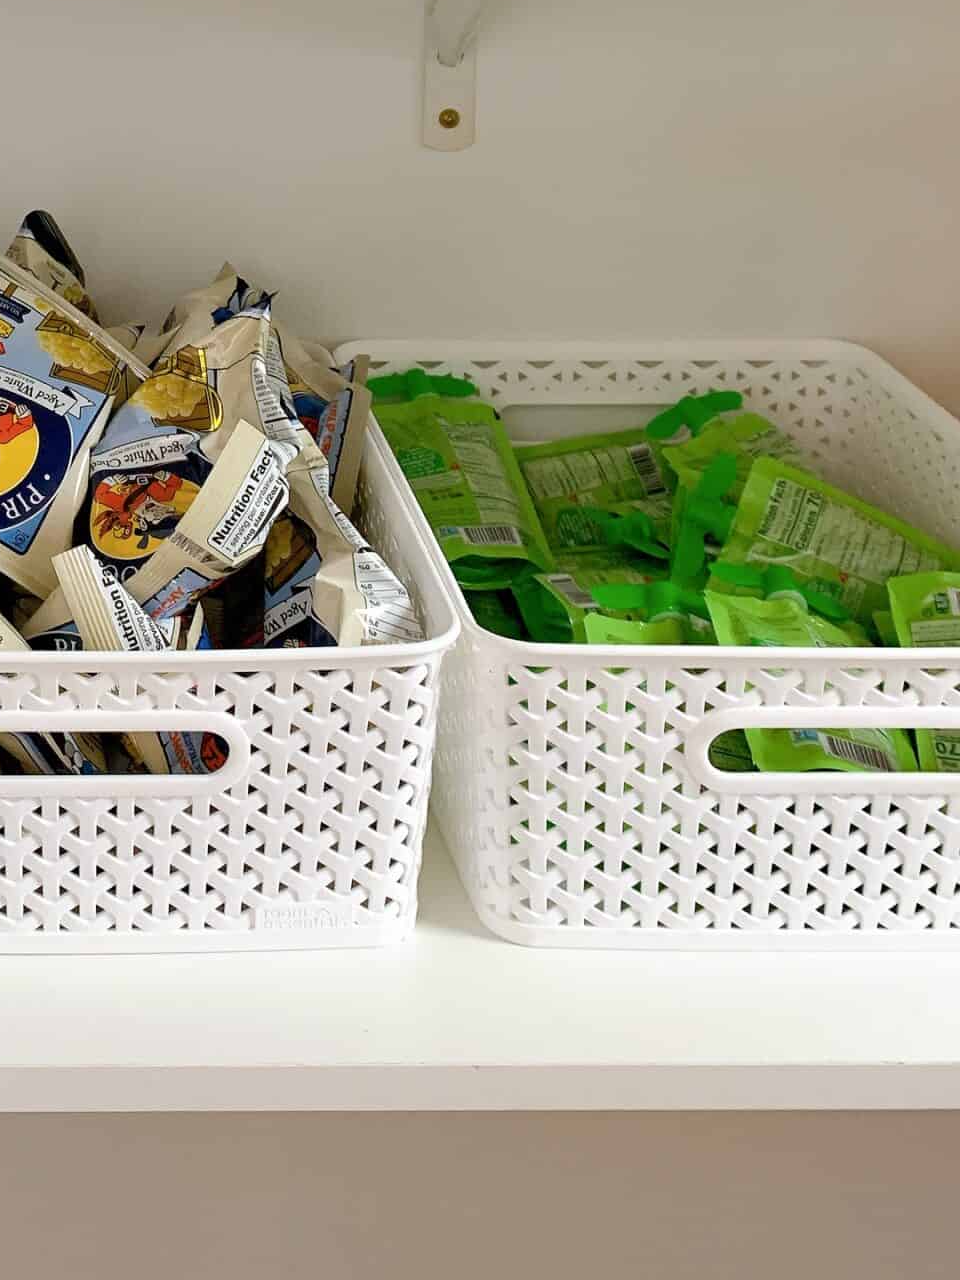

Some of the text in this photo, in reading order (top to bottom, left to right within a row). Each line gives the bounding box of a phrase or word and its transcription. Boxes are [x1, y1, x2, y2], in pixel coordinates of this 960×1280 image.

[2, 375, 34, 400] White
[34, 389, 66, 410] Aged
[125, 447, 161, 465] White
[211, 484, 256, 545] Nutrition
[250, 449, 275, 483] Fact
[279, 600, 308, 625] Aged
